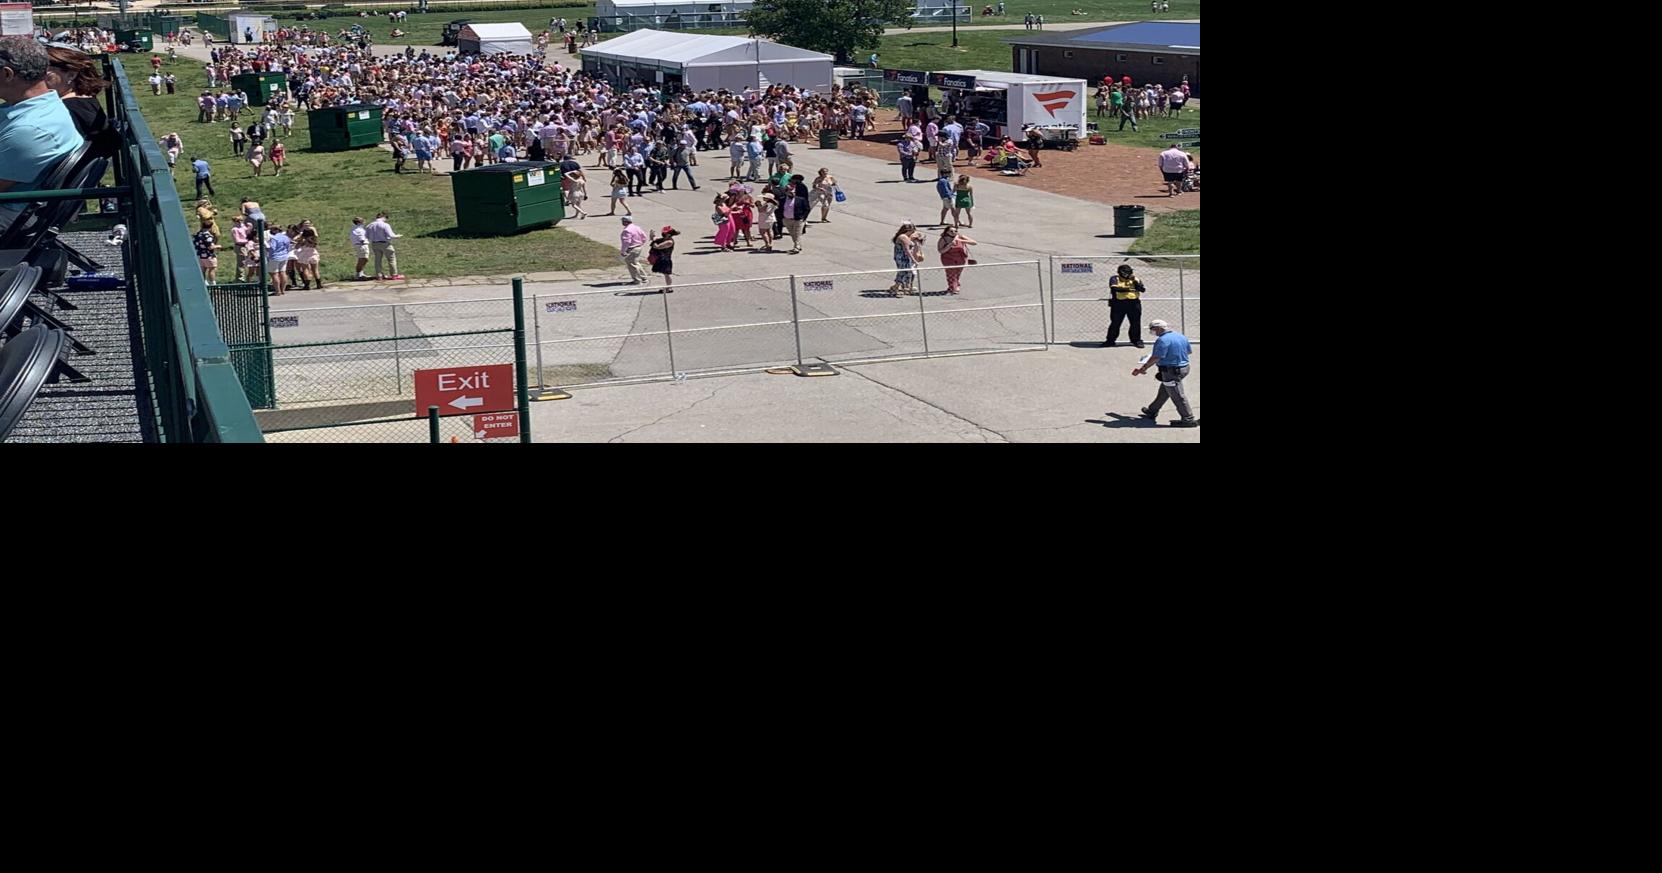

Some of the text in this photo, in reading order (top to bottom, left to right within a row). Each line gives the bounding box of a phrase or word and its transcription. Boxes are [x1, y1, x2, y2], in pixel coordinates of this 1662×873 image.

[896, 73, 918, 82] Fanatics
[944, 77, 967, 88] Fanatics
[438, 372, 490, 392] Exit
